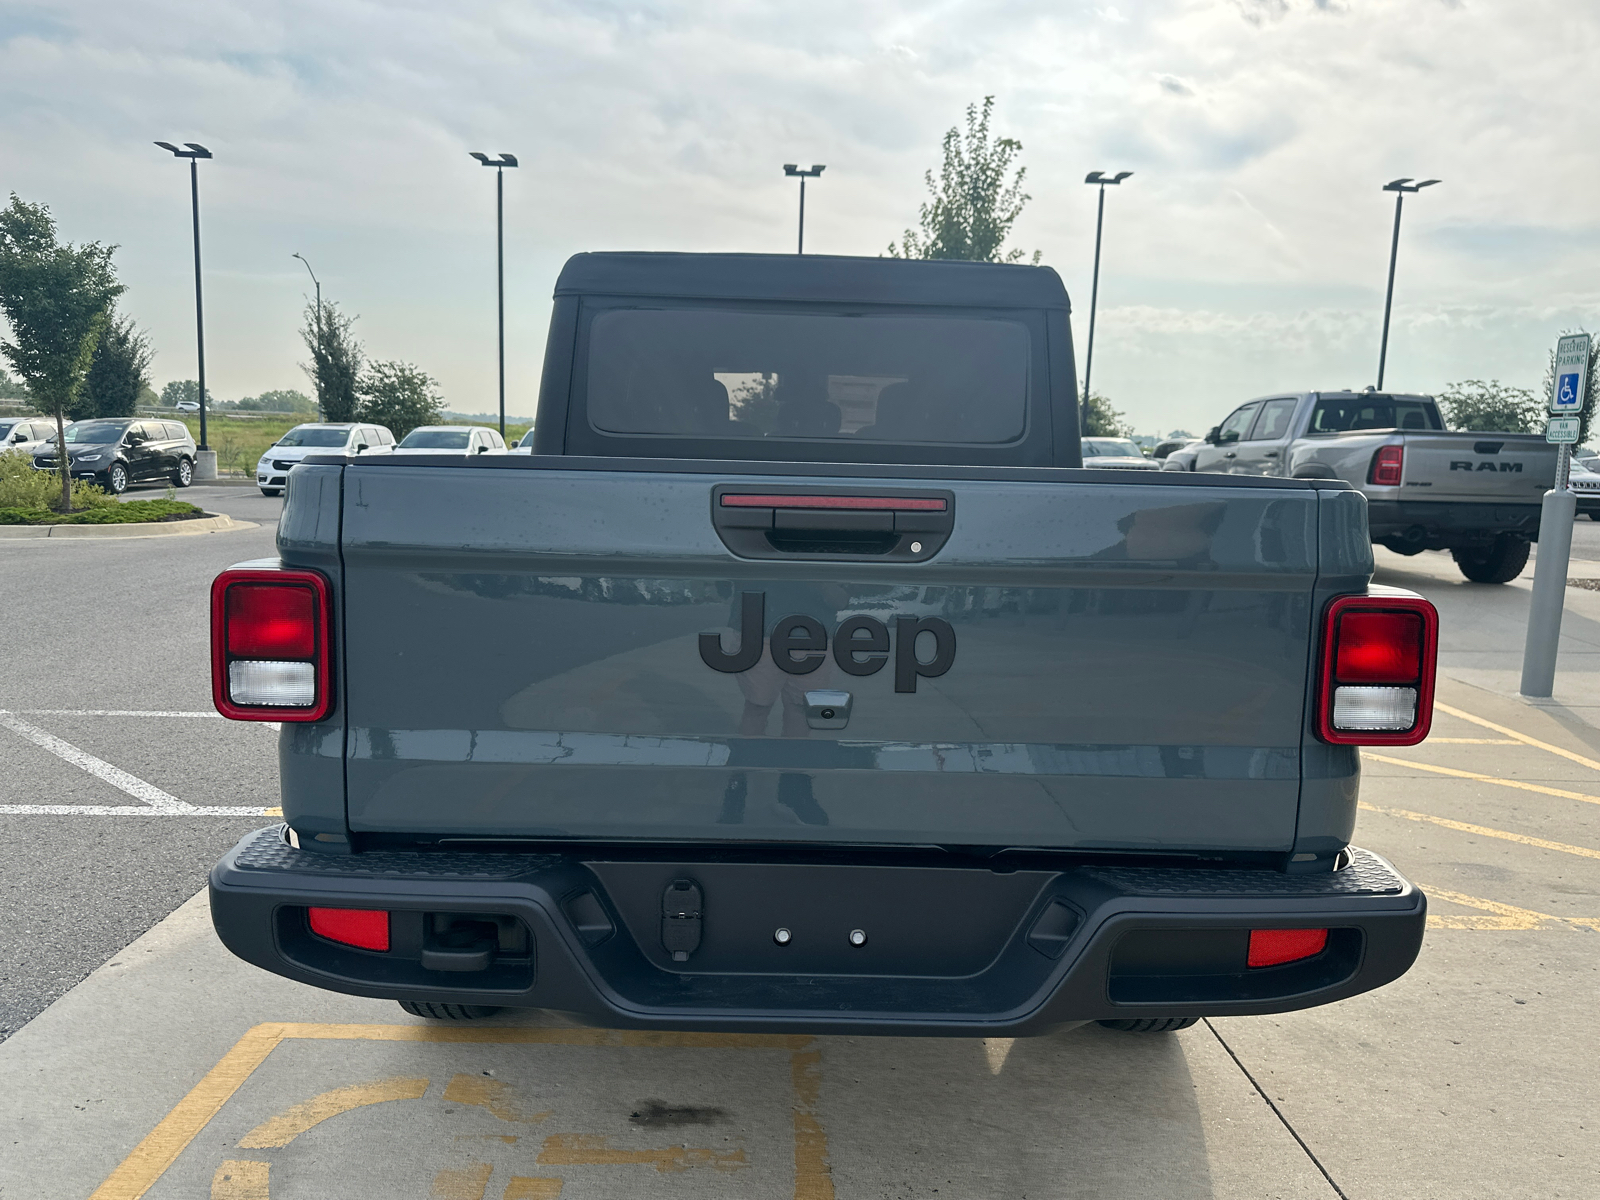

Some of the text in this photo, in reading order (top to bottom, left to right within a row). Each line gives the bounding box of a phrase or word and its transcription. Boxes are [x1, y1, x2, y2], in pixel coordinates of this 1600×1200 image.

[1559, 341, 1586, 353] RESERVED
[1557, 354, 1585, 366] PARKING
[1549, 430, 1576, 438] ACCESSIBLE
[1450, 461, 1523, 473] RAM
[699, 591, 957, 693] Jeep
